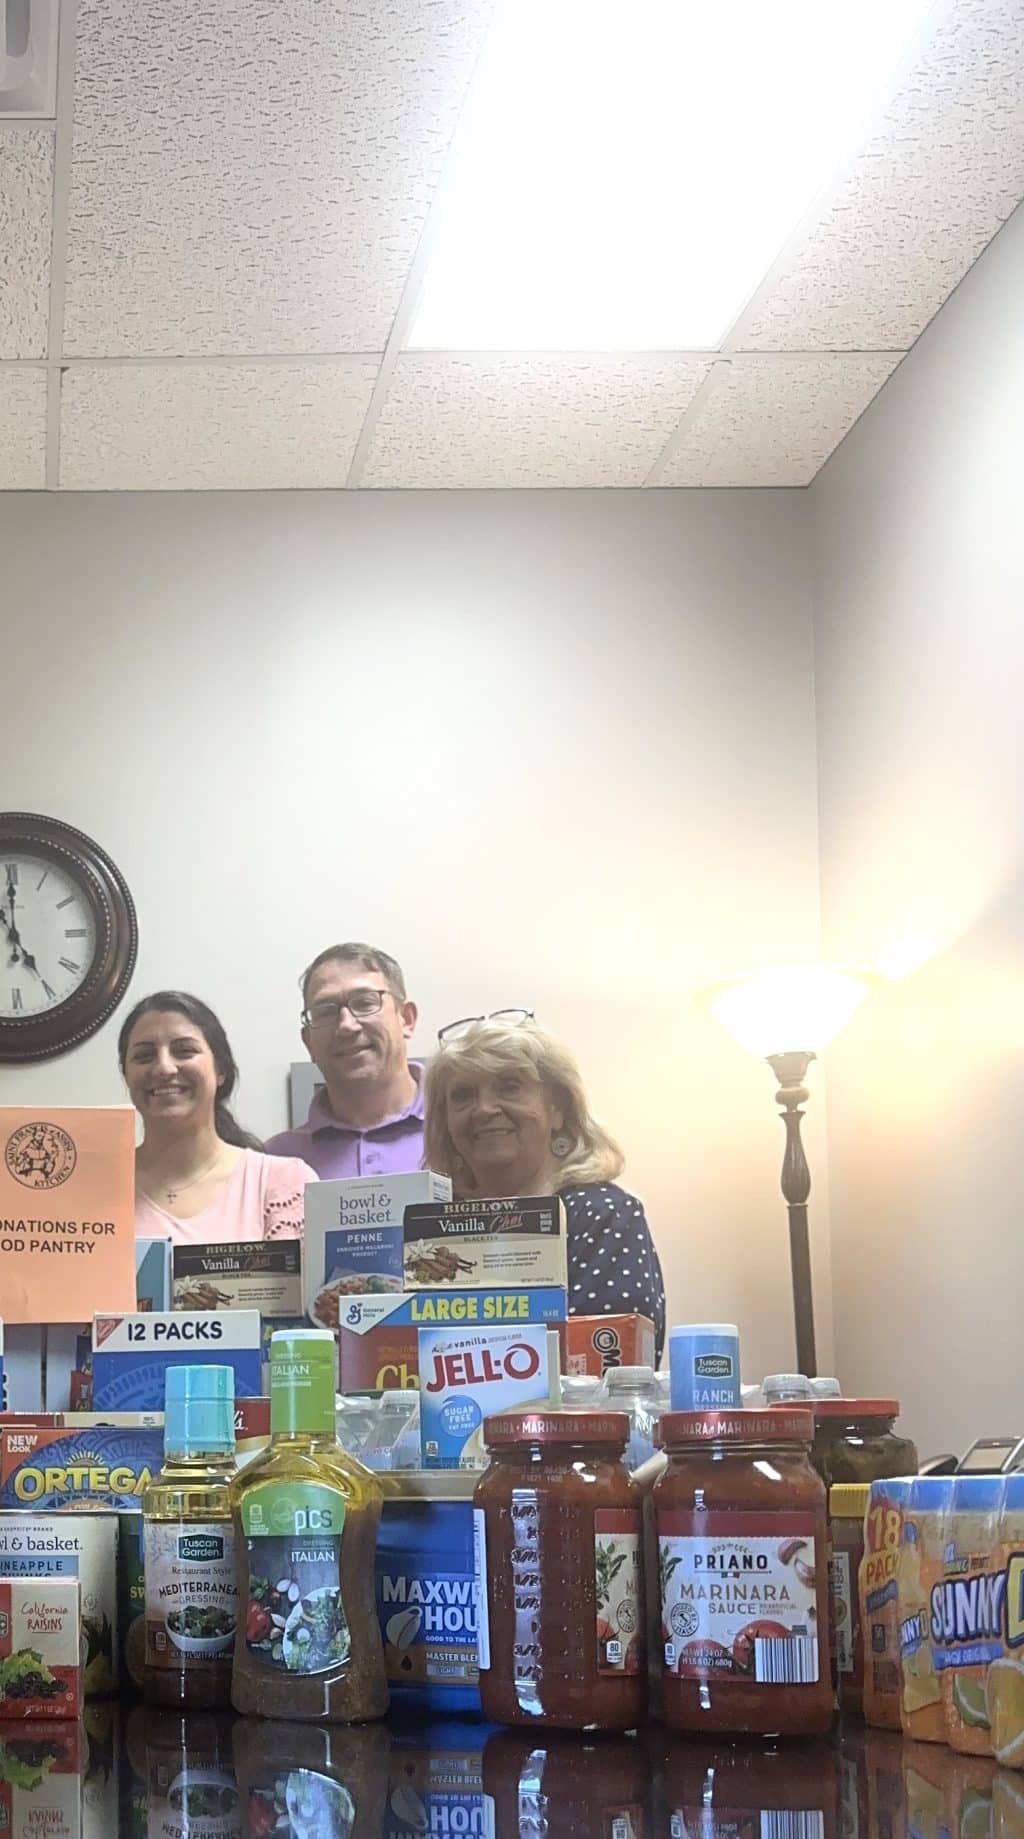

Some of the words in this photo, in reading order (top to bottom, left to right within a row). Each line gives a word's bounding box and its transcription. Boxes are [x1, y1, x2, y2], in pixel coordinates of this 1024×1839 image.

[339, 1194, 376, 1210] bowl
[378, 1194, 392, 1207] &
[443, 1201, 518, 1214] BIGELOW
[339, 1209, 392, 1226] basket
[81, 1222, 116, 1236] FOR
[438, 1218, 486, 1233] Vanilla
[347, 1233, 383, 1244] PENNE
[29, 1239, 96, 1254] PANTRY
[205, 1243, 266, 1255] BIGELOW
[201, 1258, 240, 1271] Vanilla
[410, 1297, 478, 1321] LARGE
[483, 1296, 529, 1318] SIZE
[128, 1323, 146, 1341] 12
[154, 1321, 223, 1341] PACKS
[454, 1337, 487, 1349] vanilla
[698, 1358, 728, 1367] Tuscan
[697, 1366, 729, 1374] Garden
[692, 1389, 734, 1403] RANCH
[444, 1405, 475, 1416] SUGAR
[449, 1415, 471, 1424] FREE
[7, 1435, 38, 1445] NEW
[7, 1445, 31, 1453] LOOK
[13, 1467, 153, 1502] ORTEGA
[294, 1505, 333, 1536] pics
[869, 1505, 902, 1550] 18
[11, 1536, 23, 1551] &
[183, 1538, 218, 1548] Tuscan
[182, 1547, 220, 1557] Garden
[291, 1551, 335, 1562] ITALIAN
[694, 1555, 769, 1570] PRIANO
[866, 1552, 898, 1585] PACK
[680, 1584, 791, 1601] MARINARA
[21, 1601, 68, 1618] California
[708, 1603, 757, 1615] SAUCE
[27, 1618, 62, 1631] RAISINS
[424, 1605, 478, 1633] HOU
[425, 1652, 458, 1661] MASTER
